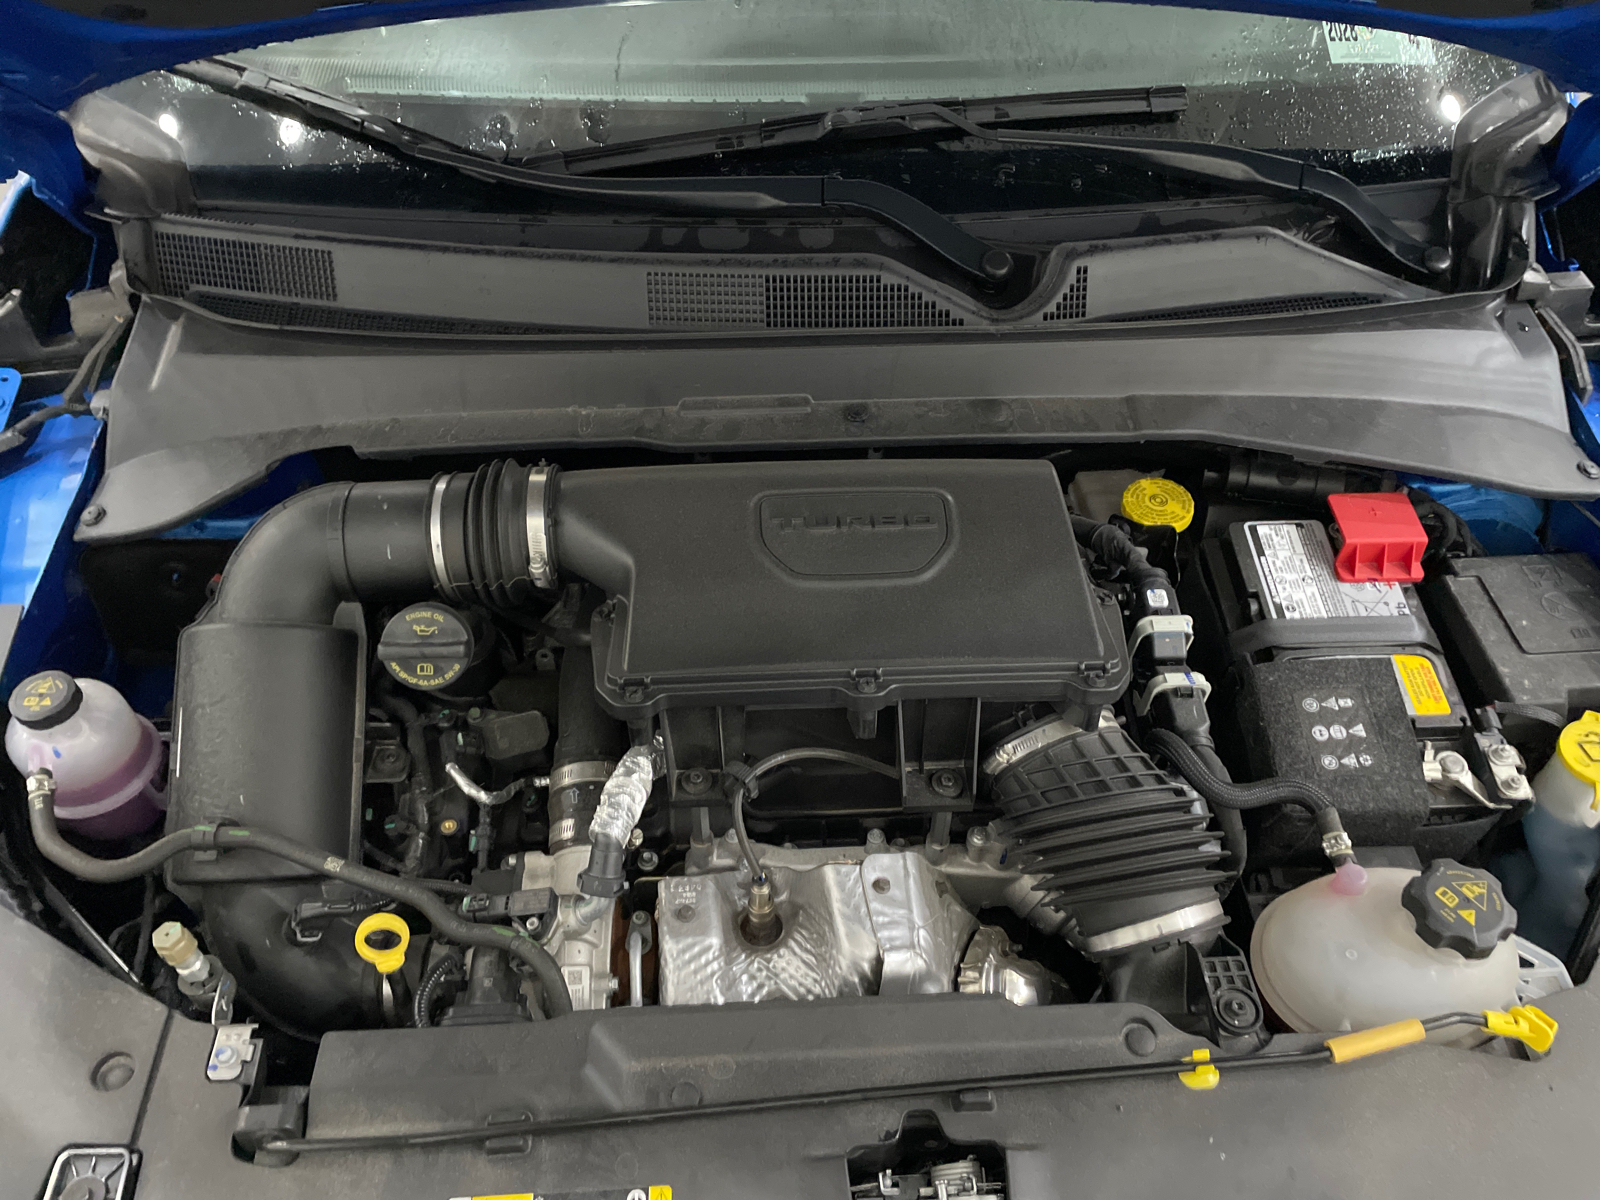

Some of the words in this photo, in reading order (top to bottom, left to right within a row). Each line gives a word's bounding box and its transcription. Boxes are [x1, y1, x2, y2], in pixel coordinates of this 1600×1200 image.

[770, 514, 939, 533] TURBO
[405, 611, 432, 621] ENGINE
[433, 613, 444, 623] OIL
[390, 662, 401, 673] API
[444, 663, 461, 680] 5W-30
